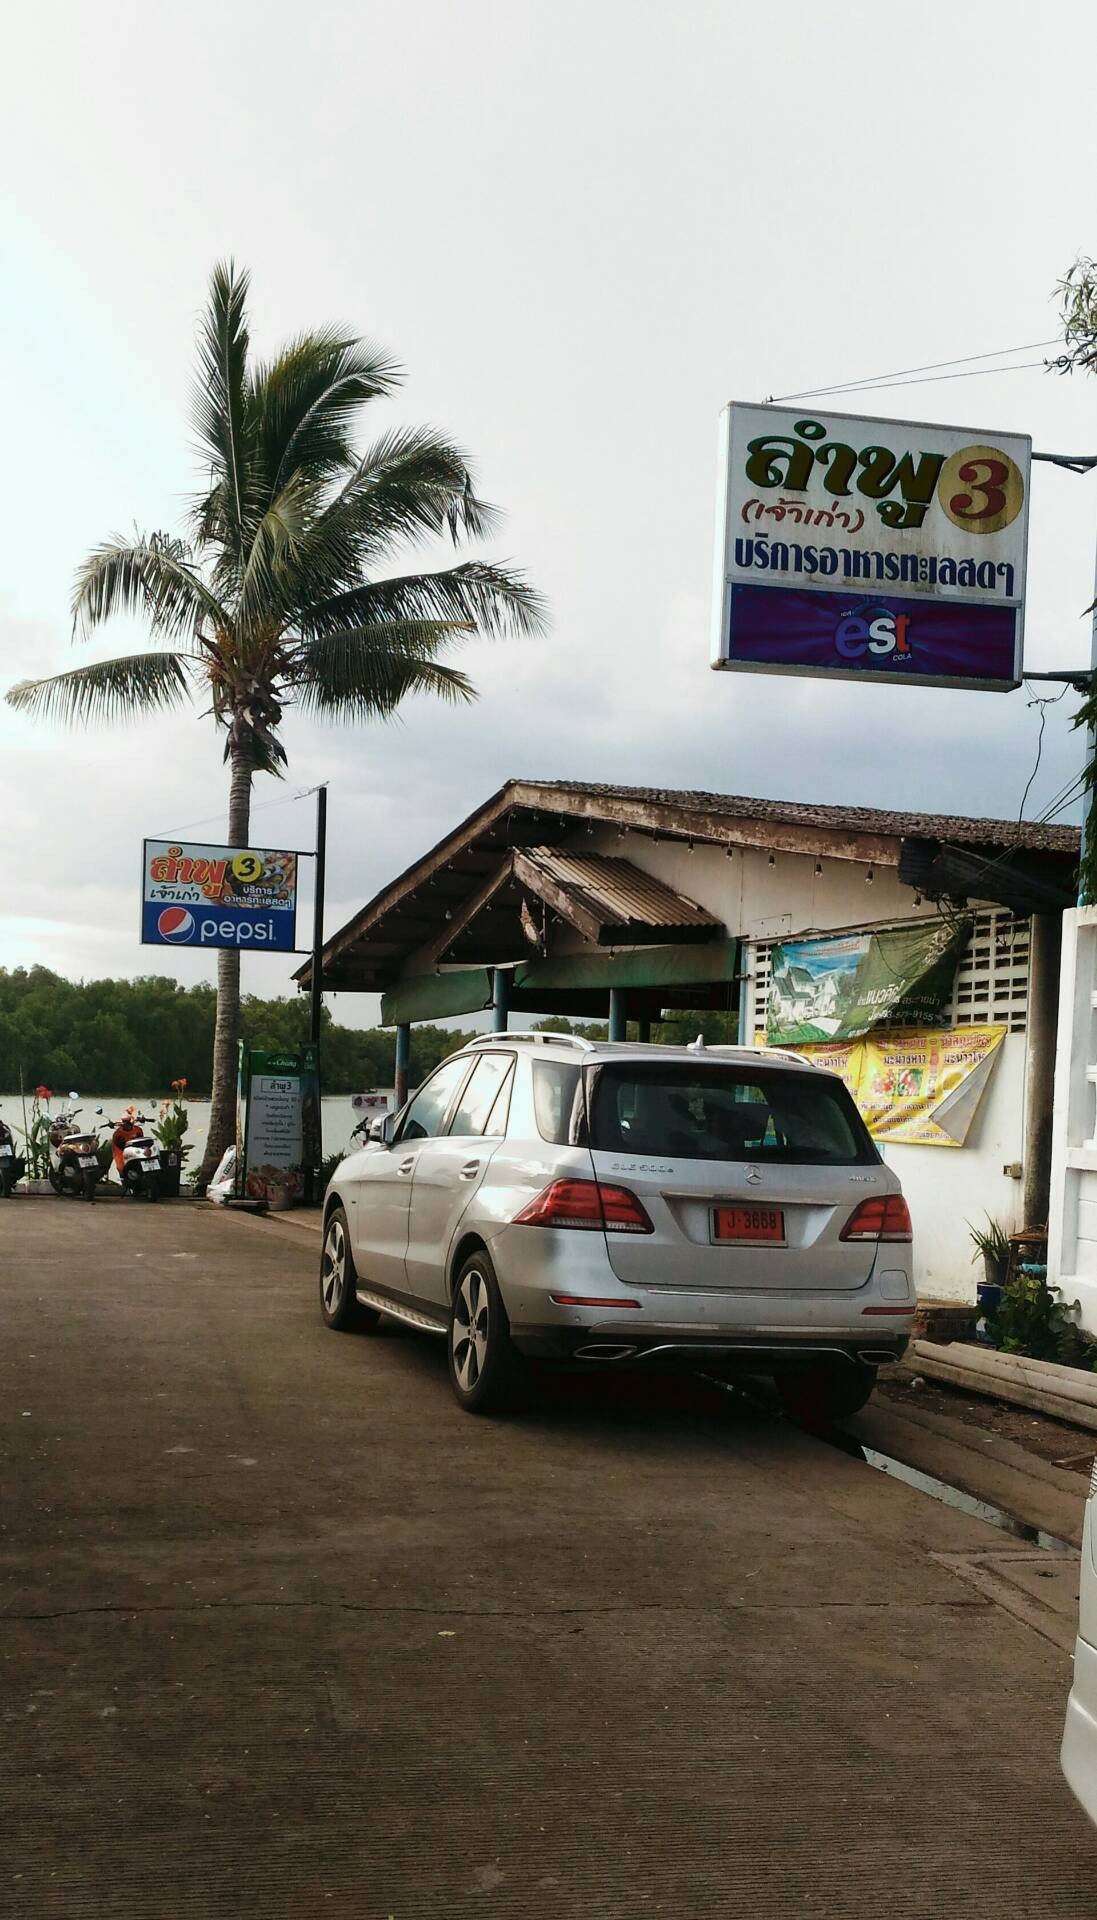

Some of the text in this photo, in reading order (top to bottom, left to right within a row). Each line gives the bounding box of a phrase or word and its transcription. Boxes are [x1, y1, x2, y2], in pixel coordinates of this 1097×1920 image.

[745, 419, 1011, 530] ลำพู 3
[741, 497, 865, 534] (เจ้าเก่า)
[735, 532, 1014, 597] บริการอาหารทะเลสดๆ
[834, 613, 911, 659] est
[892, 653, 912, 662] COLA
[150, 845, 256, 899] ลำพู 3
[243, 885, 273, 895] บริการ
[150, 885, 200, 902] เจ้าเก่า
[200, 919, 273, 944] pepsi
